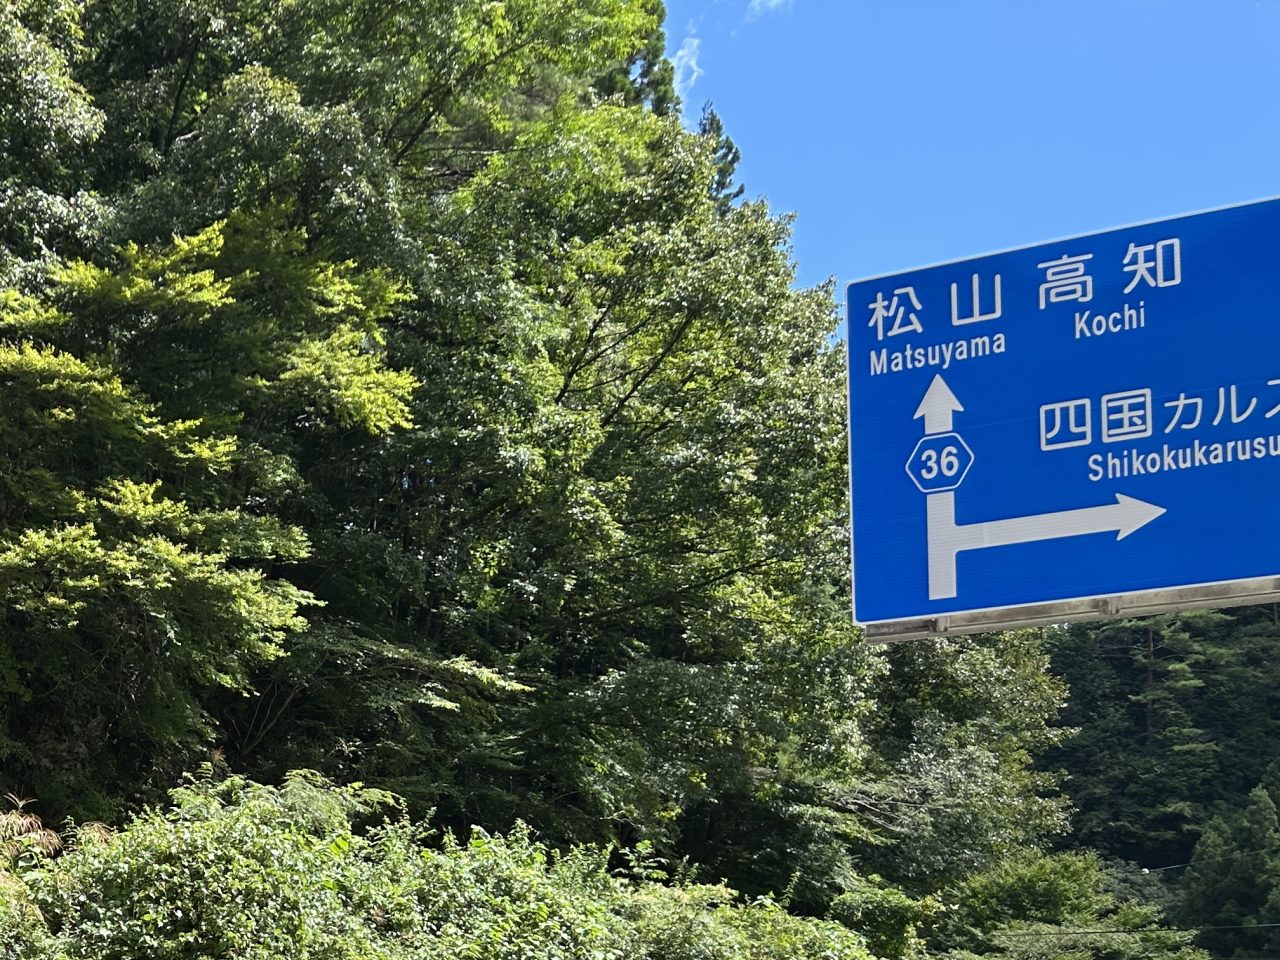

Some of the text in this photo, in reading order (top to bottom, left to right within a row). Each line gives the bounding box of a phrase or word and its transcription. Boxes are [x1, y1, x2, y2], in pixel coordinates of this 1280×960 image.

[868, 238, 1181, 340] 松山 高知
[1075, 301, 1145, 339] Kochi
[870, 333, 1006, 376] Matsuyama
[920, 446, 959, 480] 36
[1088, 434, 1280, 481] Shikokukarusu
